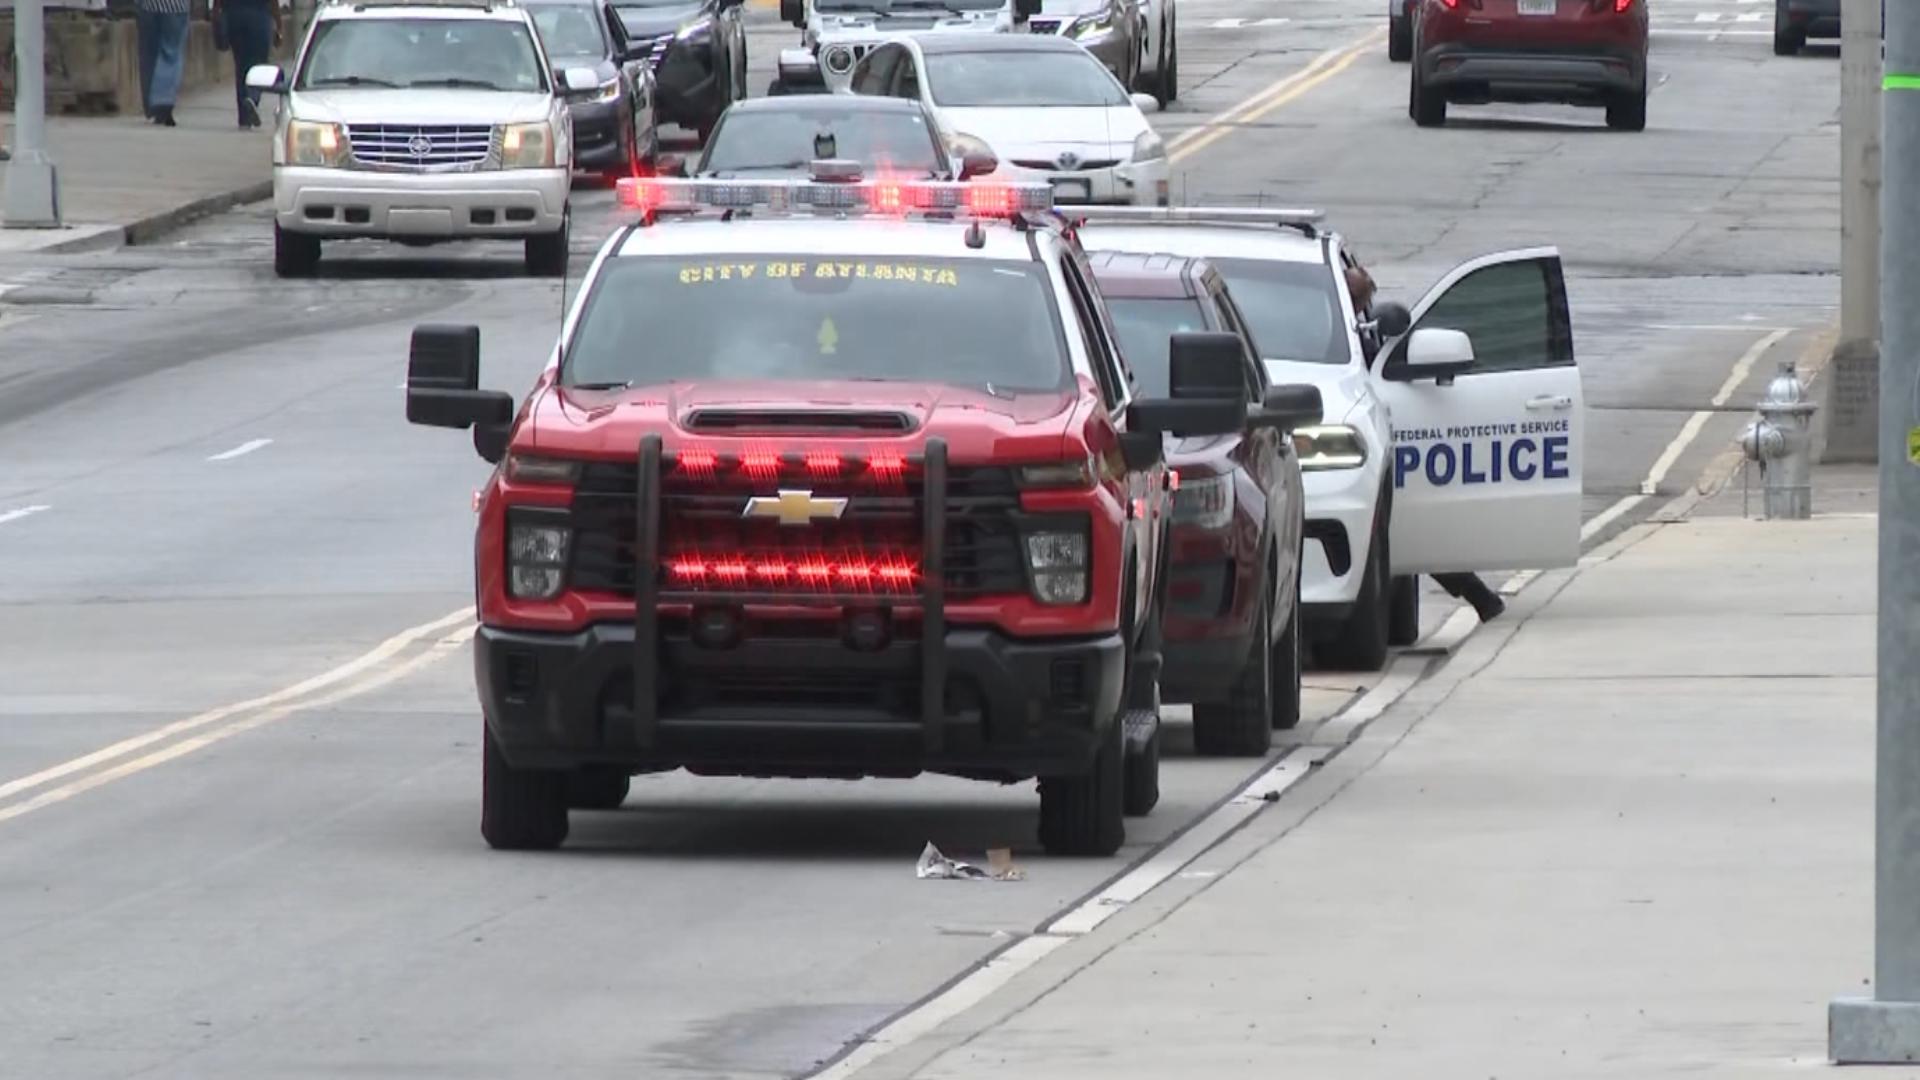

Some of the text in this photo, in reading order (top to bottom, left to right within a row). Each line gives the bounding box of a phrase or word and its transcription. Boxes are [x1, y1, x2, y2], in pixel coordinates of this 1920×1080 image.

[680, 263, 957, 286] CITY OF ATLANTA
[1394, 420, 1569, 442] FEDERAL PROTECTIVE SERVICE
[1394, 437, 1569, 488] POLICE
